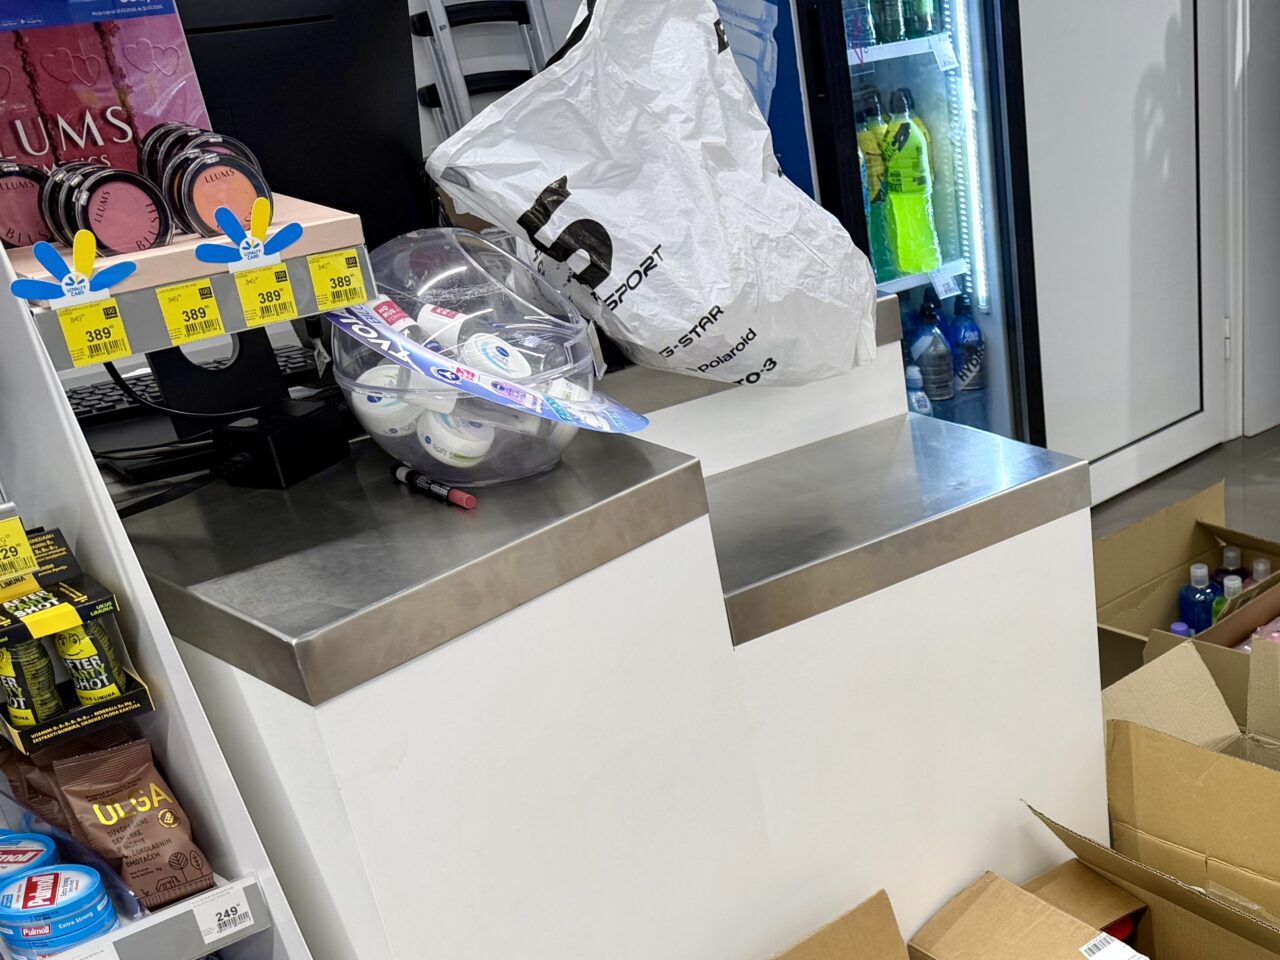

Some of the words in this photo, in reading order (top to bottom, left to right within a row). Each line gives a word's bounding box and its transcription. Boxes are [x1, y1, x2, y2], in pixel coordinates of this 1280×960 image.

[329, 275, 352, 290] 389
[603, 244, 665, 312] SPORT
[258, 289, 282, 304] 389
[181, 306, 207, 322] 389
[85, 326, 112, 343] 389
[659, 305, 725, 360] G-STAR
[697, 328, 758, 374] Polaroid
[14, 600, 60, 619] SHOT
[215, 905, 239, 923] 249
[22, 925, 51, 937] Pulmoll
